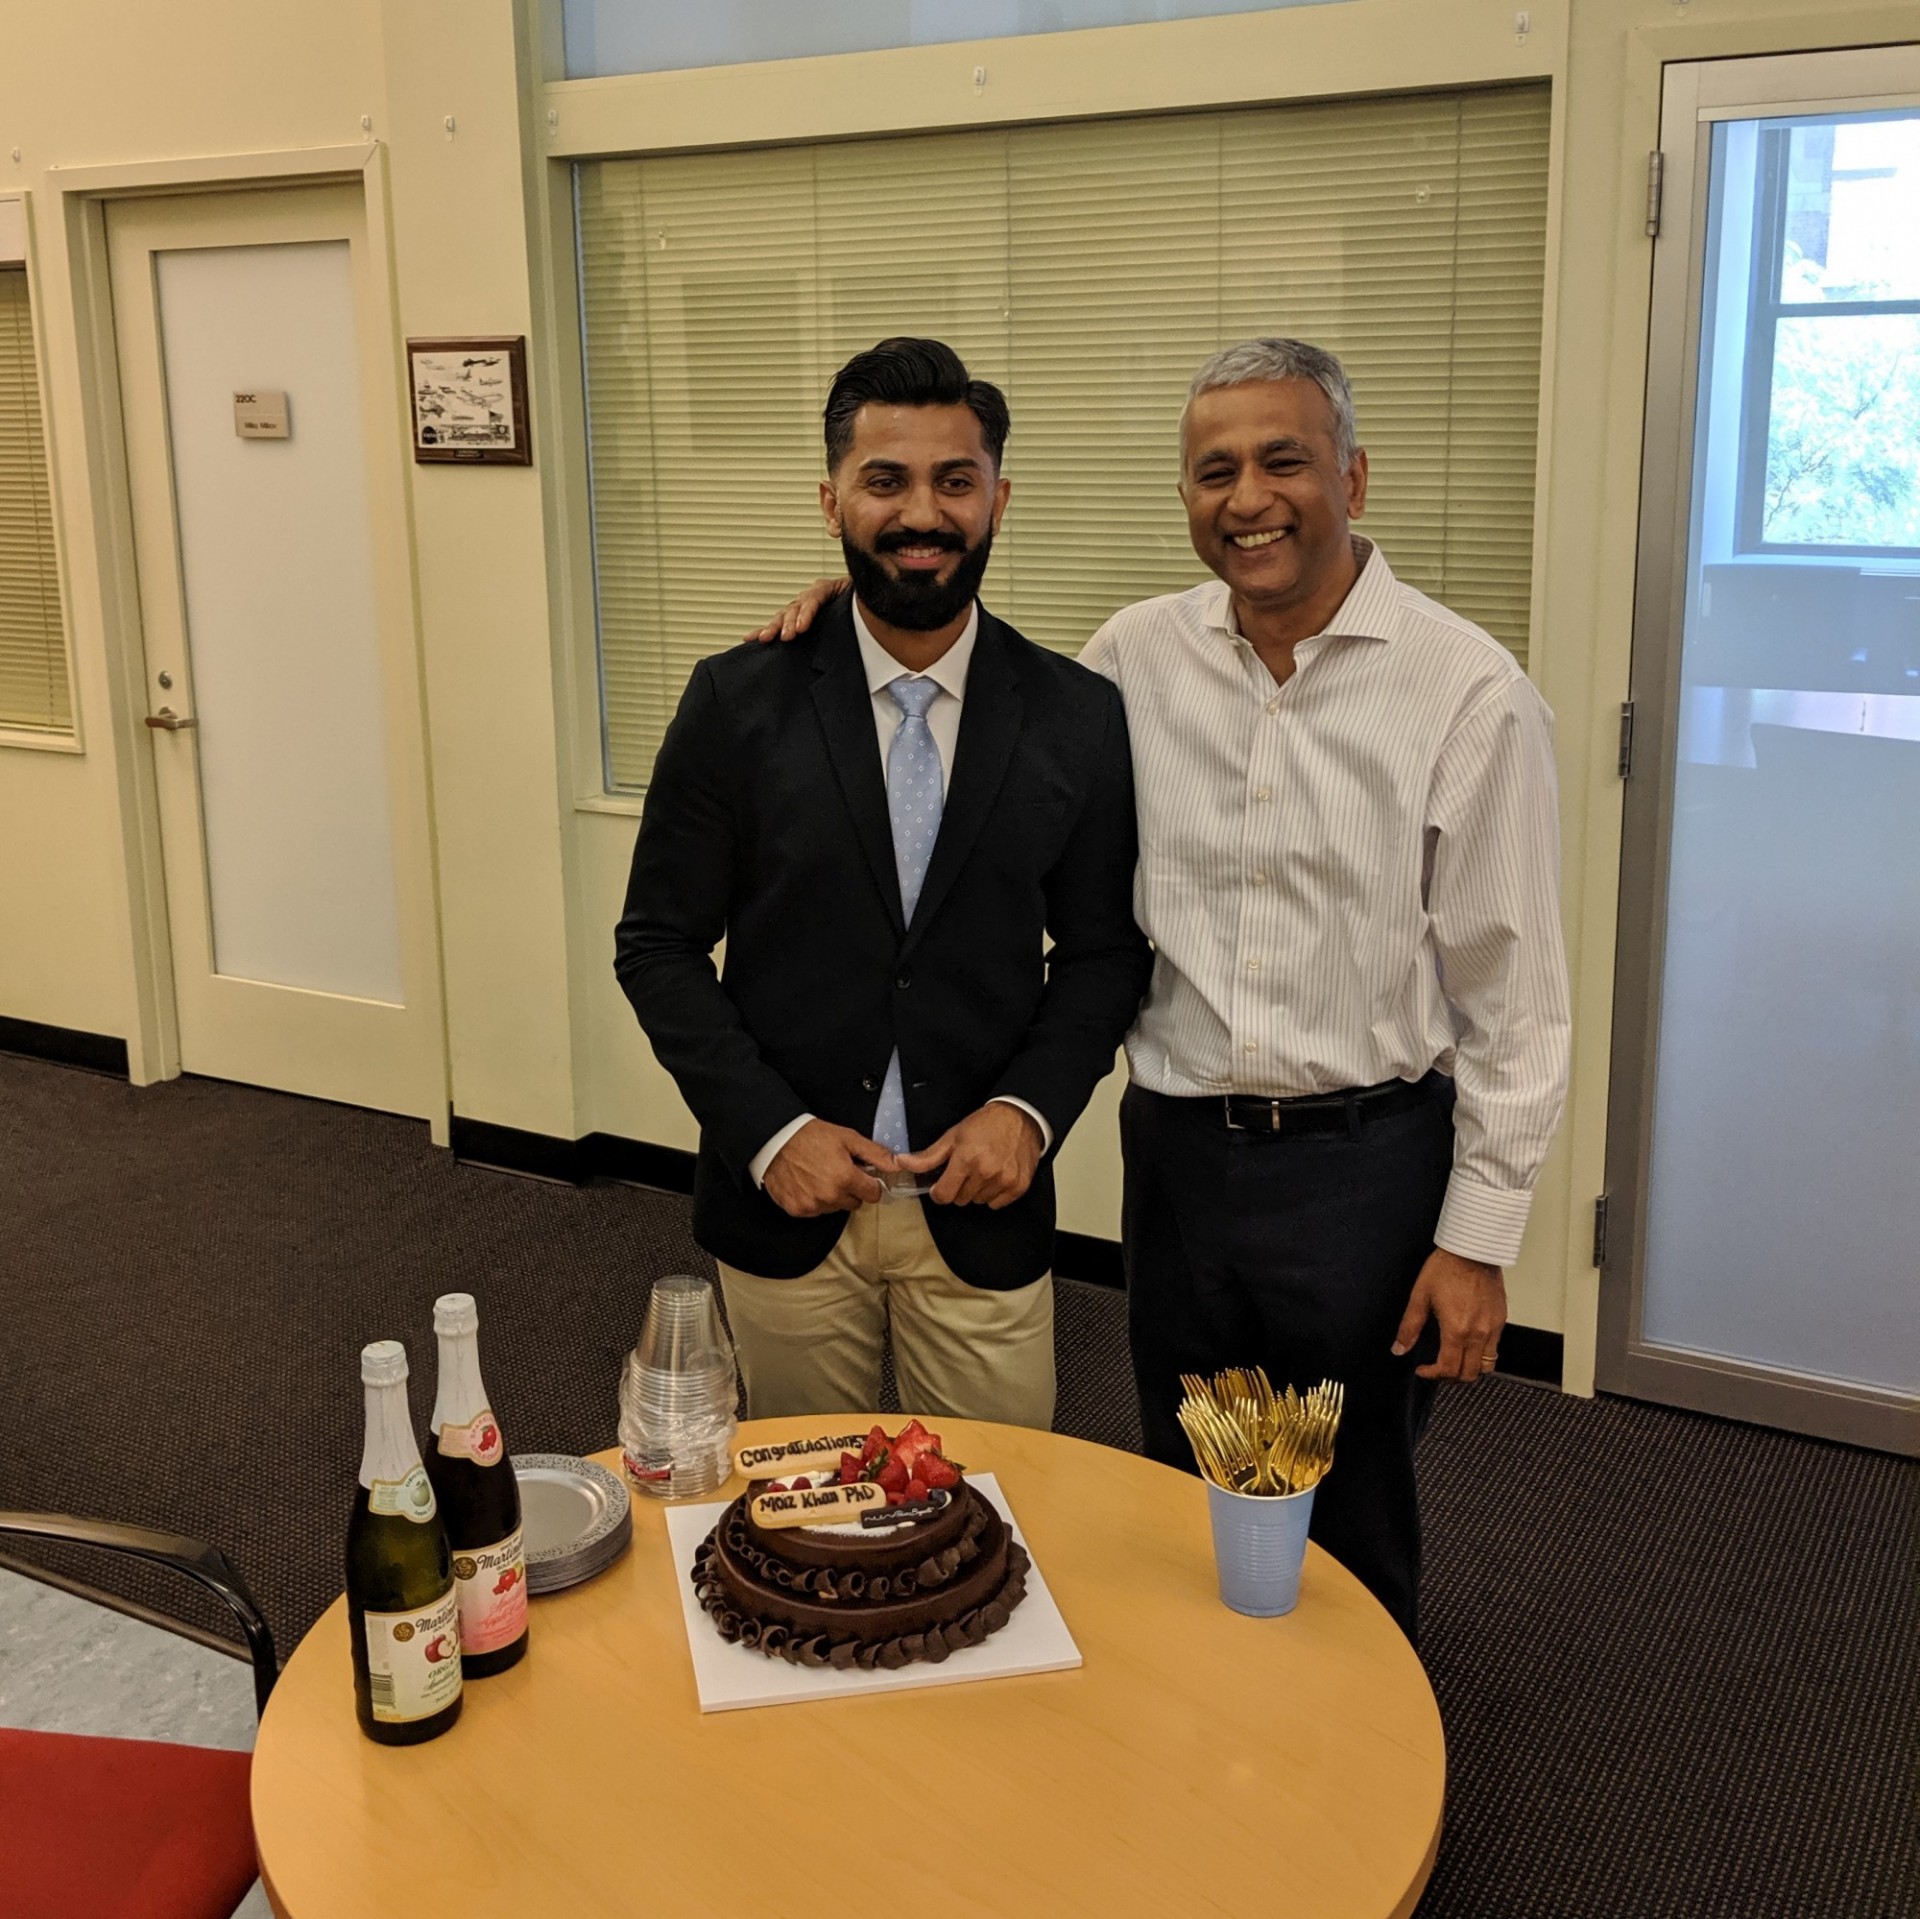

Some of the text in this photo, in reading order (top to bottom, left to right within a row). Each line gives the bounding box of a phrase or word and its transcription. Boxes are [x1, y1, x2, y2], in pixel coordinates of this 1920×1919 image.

[235, 394, 257, 404] 220C
[740, 1436, 864, 1468] Congratulations
[801, 1490, 839, 1509] Khan
[841, 1485, 876, 1503] PhD
